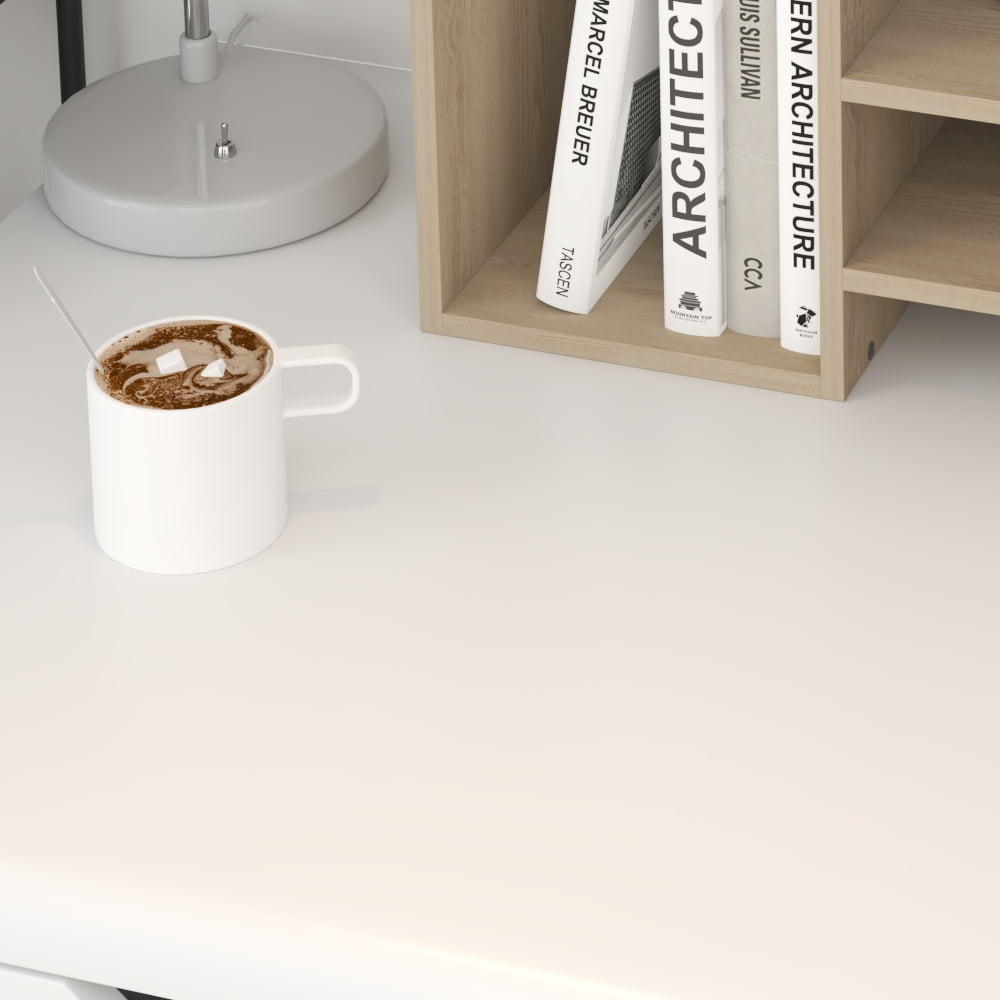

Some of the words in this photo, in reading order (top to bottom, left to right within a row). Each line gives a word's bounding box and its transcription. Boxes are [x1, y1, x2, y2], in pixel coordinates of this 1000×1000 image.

[739, 25, 761, 101] SULLIVAN
[571, 83, 599, 167] BREUER
[791, 60, 816, 271] ARCHITECTURE
[555, 247, 575, 298] TASCEN
